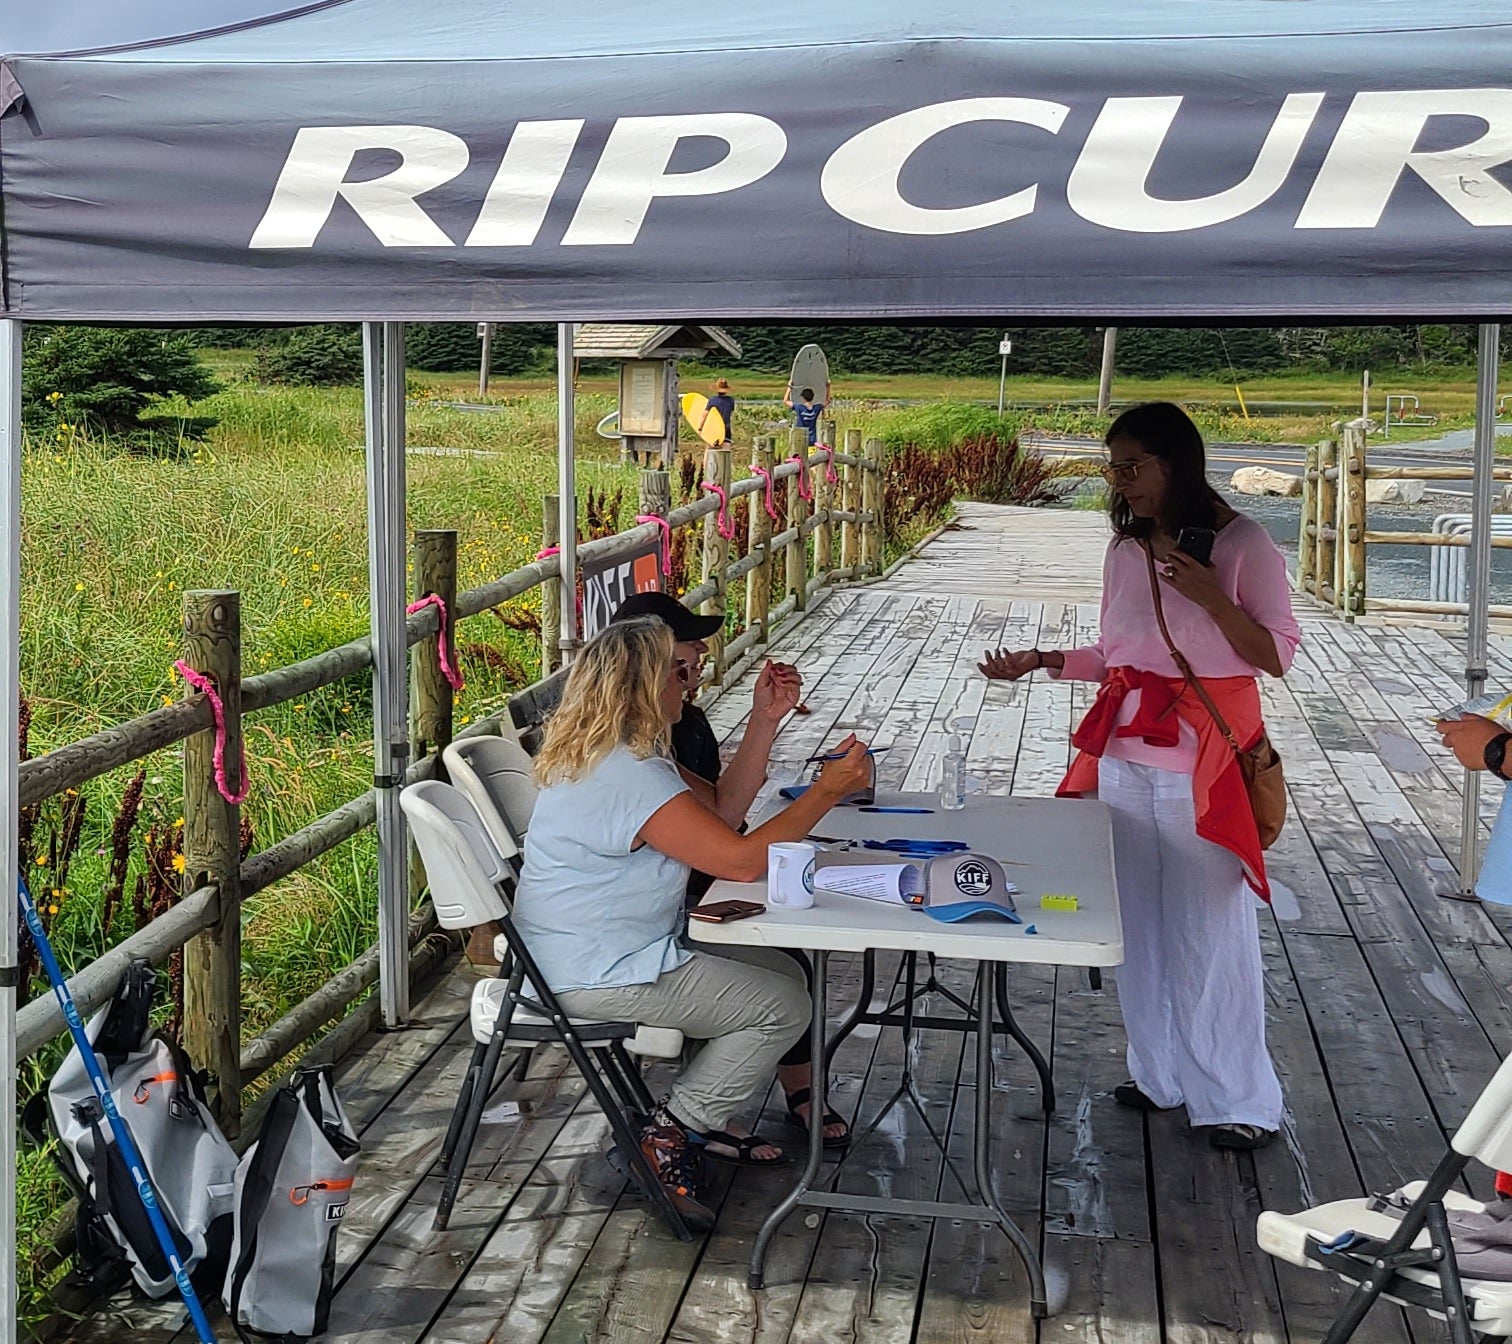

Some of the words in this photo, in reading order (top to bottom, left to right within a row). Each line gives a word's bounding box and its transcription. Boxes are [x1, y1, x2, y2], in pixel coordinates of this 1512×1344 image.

[249, 113, 787, 248] RIP
[820, 87, 1512, 234] CUR
[956, 872, 989, 883] KIFF
[332, 1206, 346, 1218] KI
